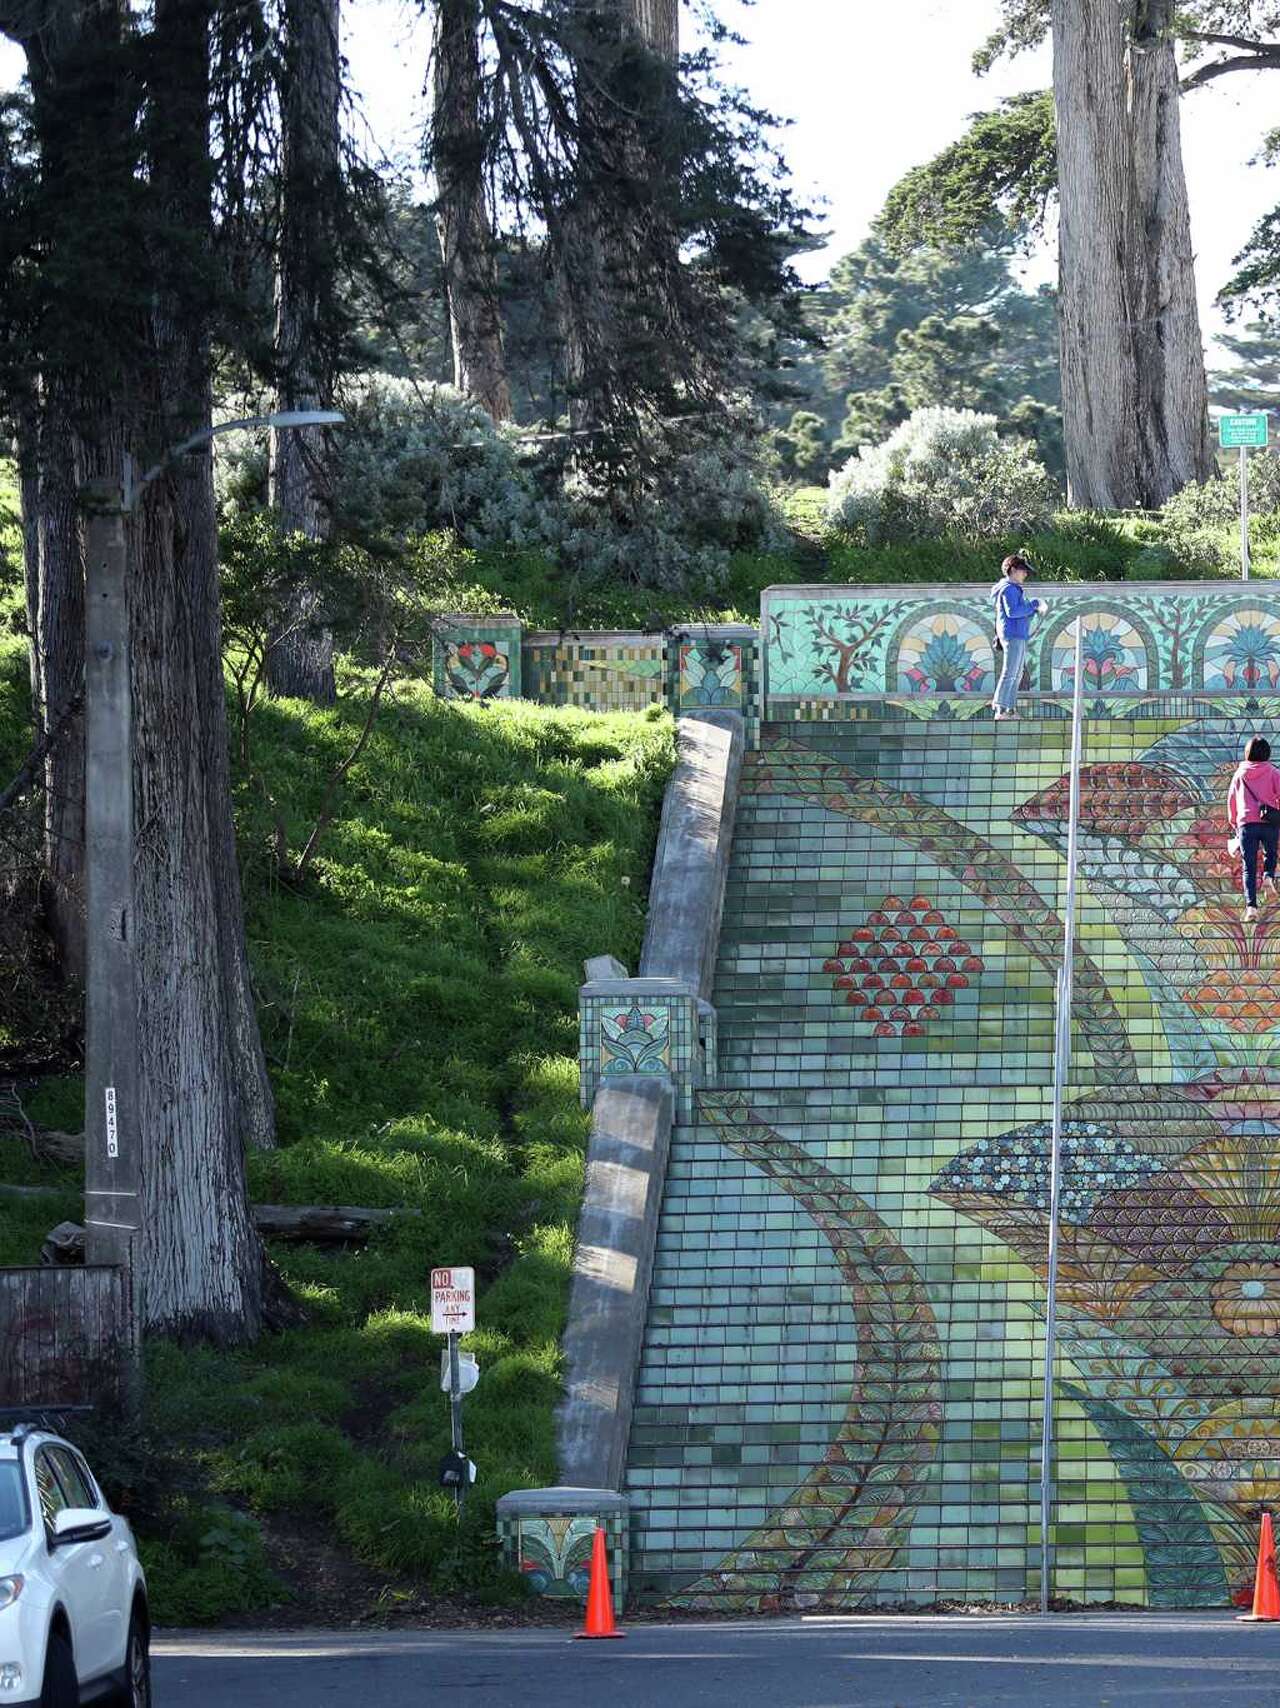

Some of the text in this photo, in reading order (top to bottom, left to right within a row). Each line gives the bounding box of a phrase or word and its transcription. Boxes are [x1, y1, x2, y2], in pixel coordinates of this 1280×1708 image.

[107, 1090, 116, 1154] 89470
[434, 1271, 449, 1287] NO
[435, 1290, 471, 1303] PARKING
[446, 1304, 460, 1312] ANY
[446, 1316, 460, 1325] TIME
